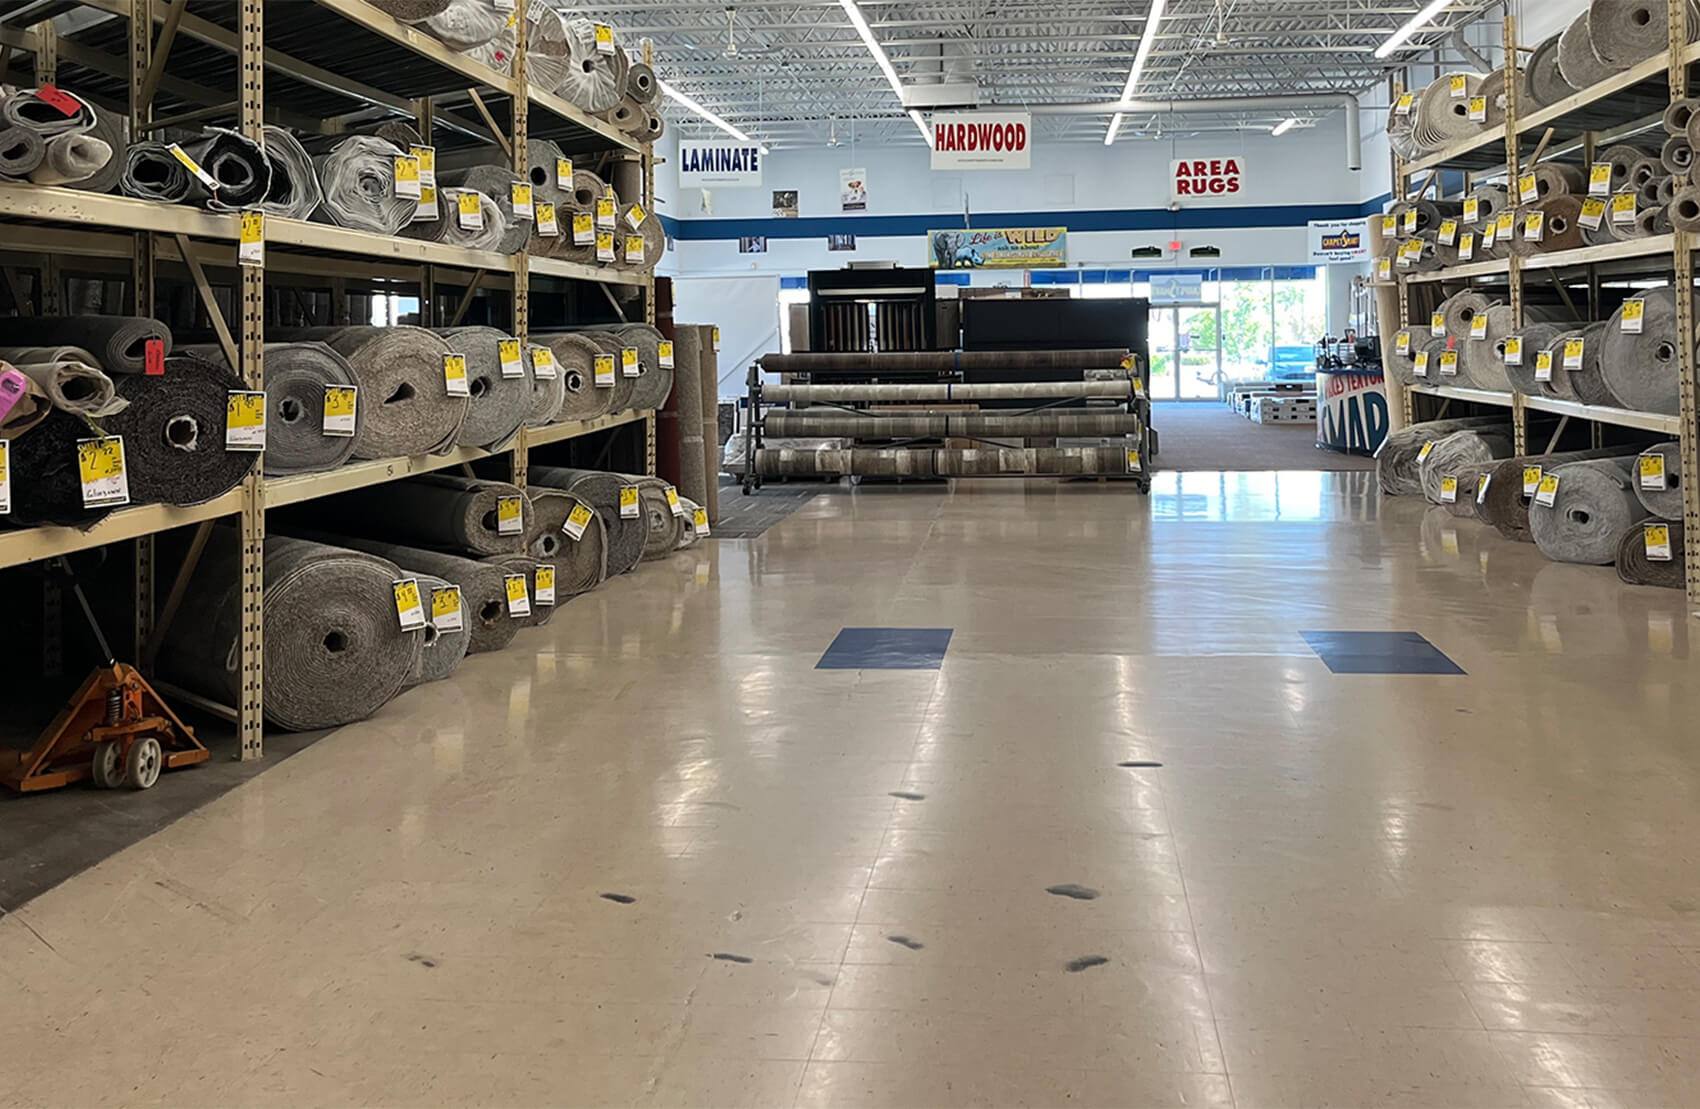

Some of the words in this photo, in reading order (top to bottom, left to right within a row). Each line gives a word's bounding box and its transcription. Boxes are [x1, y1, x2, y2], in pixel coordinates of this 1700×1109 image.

[935, 122, 1026, 152] HARDWOOD
[682, 148, 758, 172] LAMINATE
[1175, 159, 1240, 177] AREA
[1176, 177, 1240, 195] RUGS
[969, 231, 993, 245] Life
[993, 231, 1003, 240] is
[1003, 229, 1061, 245] WILD
